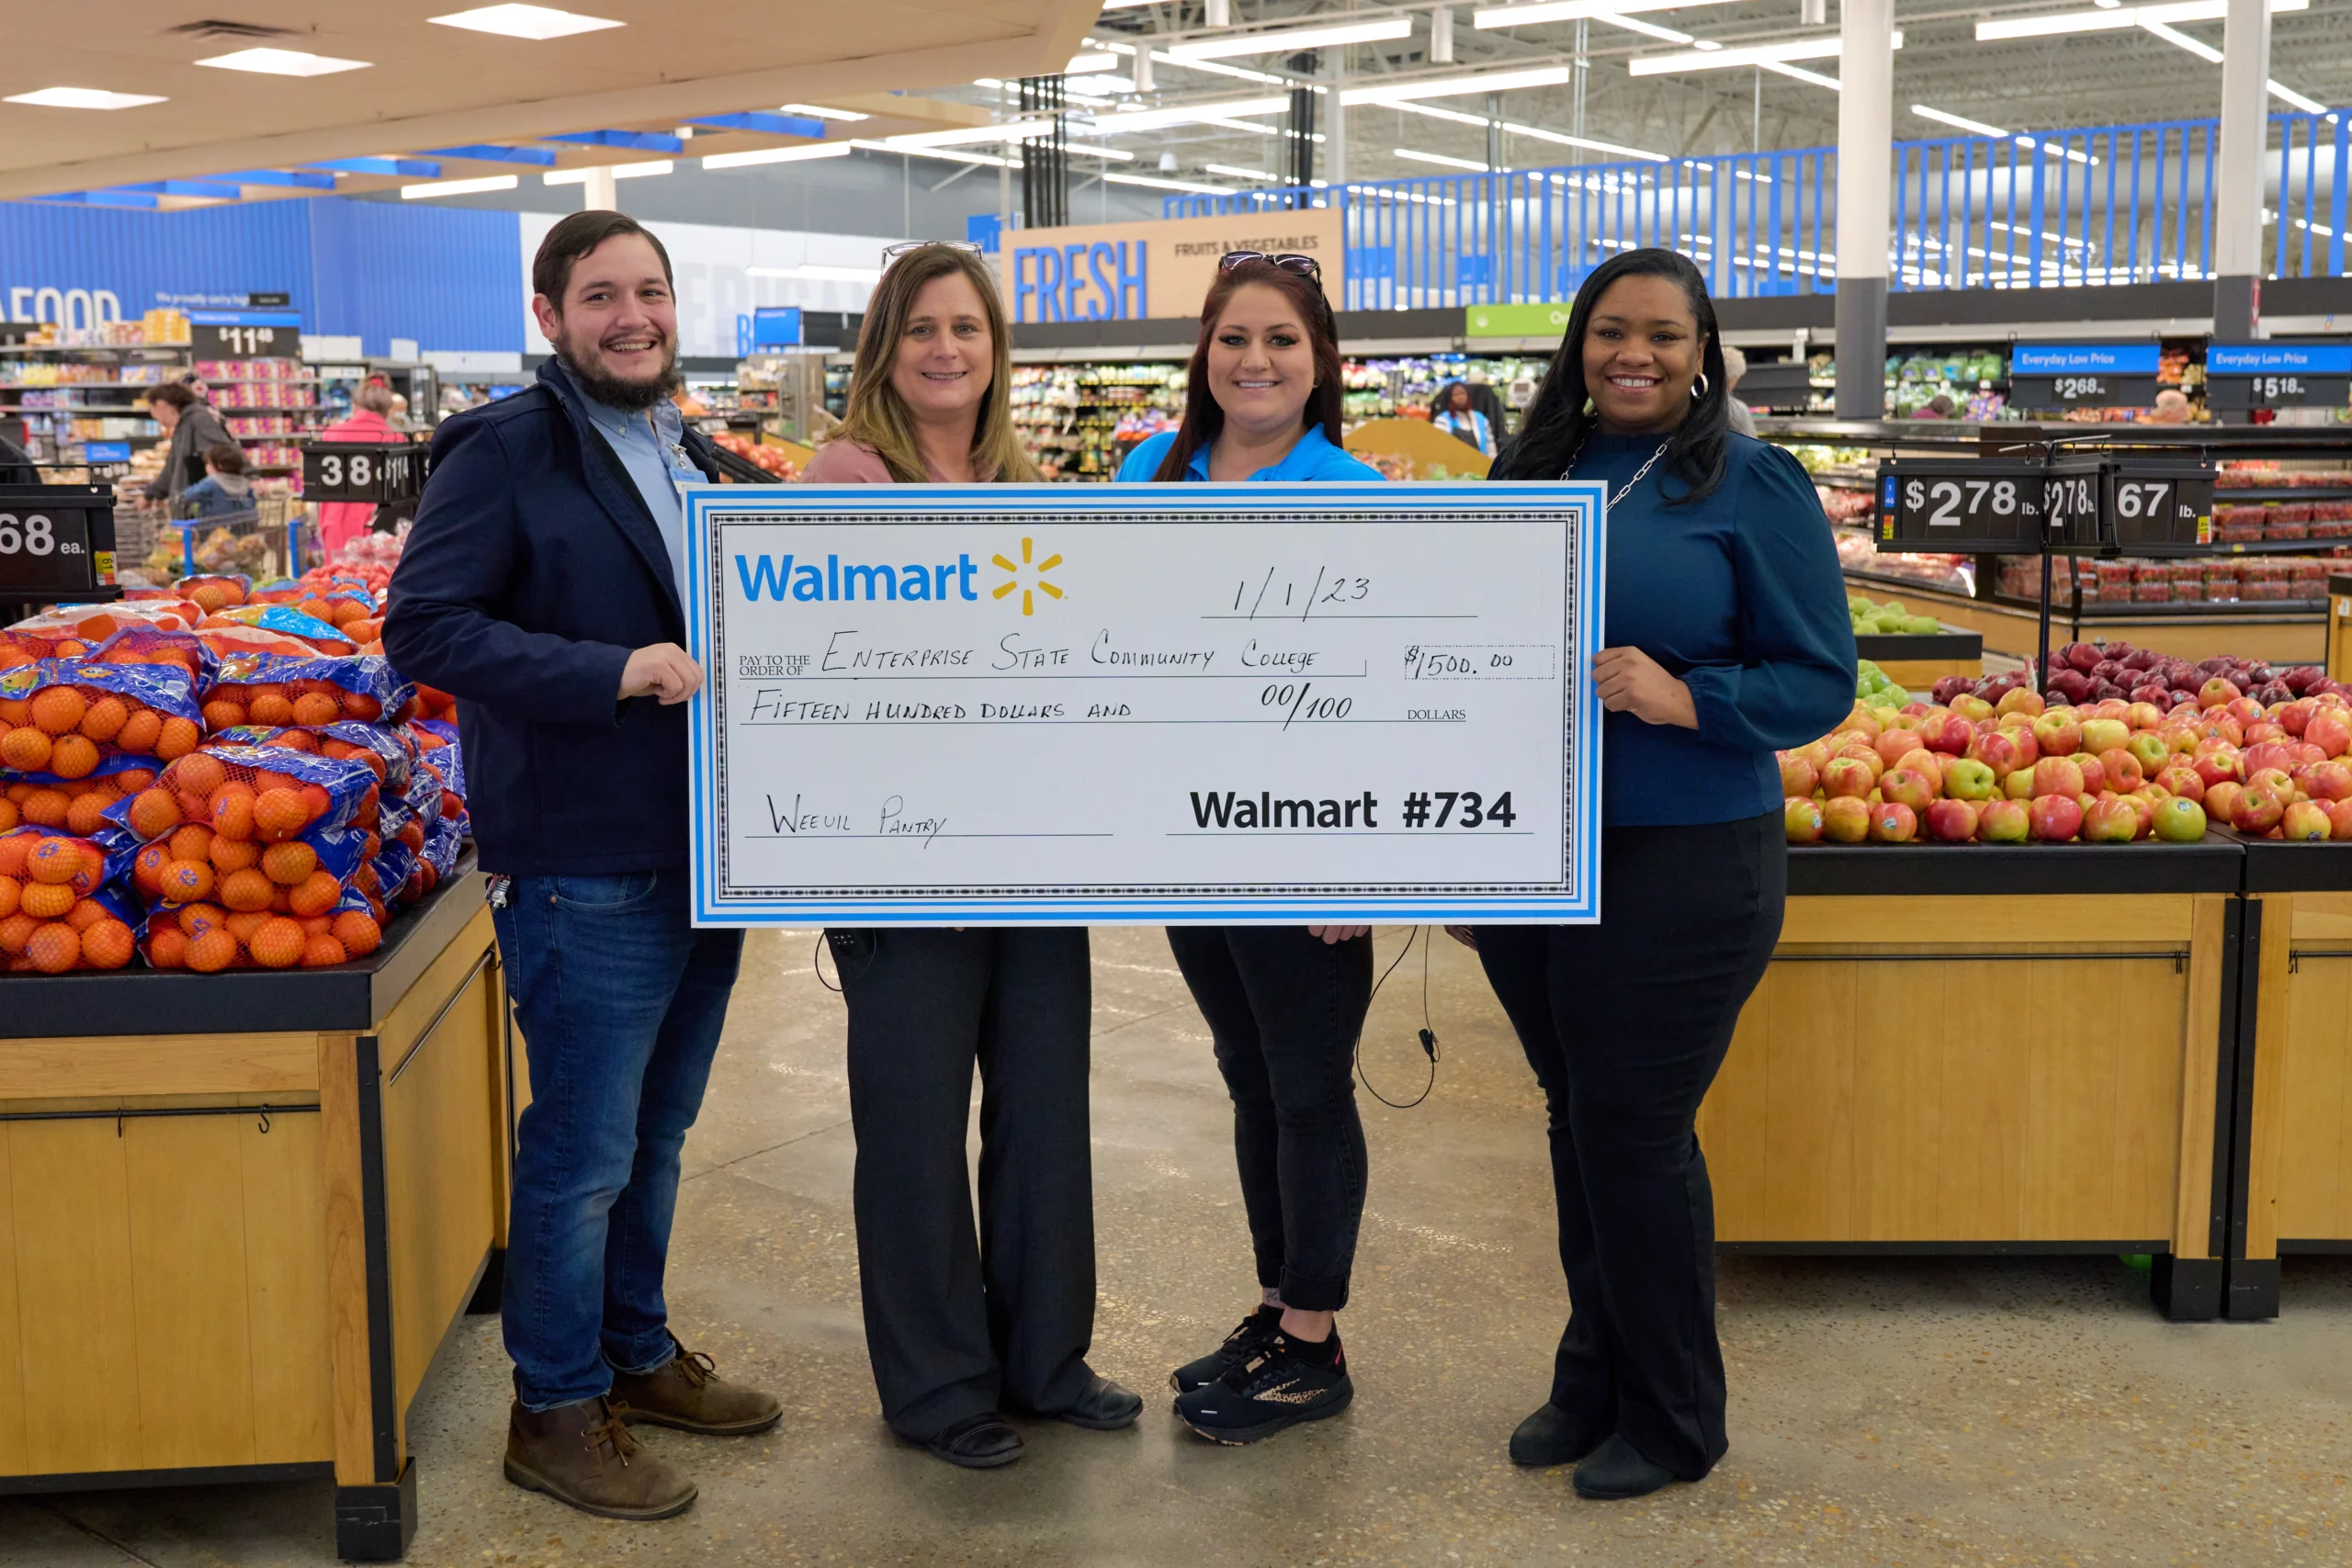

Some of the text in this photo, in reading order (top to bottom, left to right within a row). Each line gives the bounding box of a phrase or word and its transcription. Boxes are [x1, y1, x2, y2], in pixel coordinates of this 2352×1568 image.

[1175, 242, 1220, 257] FRUITS
[1235, 235, 1318, 253] VEGETABLES
[1013, 240, 1147, 324] FRESH
[0, 287, 121, 332] FOOD
[2022, 353, 2115, 367] Everyday Low Price
[2215, 353, 2308, 367] Everyday Low Price
[2054, 378, 2098, 399] $268
[1905, 479, 2040, 526] $278 lb.
[2117, 483, 2197, 518] 67 lb.
[60, 541, 85, 555] ea.
[735, 553, 978, 602] Walmart
[1234, 565, 1371, 623] 1/1/23
[740, 655, 810, 665] PAY TO THE
[822, 630, 975, 671] ENTERPRISE
[991, 633, 1070, 671] STATE
[1091, 628, 1216, 672] COMMUNITY
[740, 666, 804, 676] ORDER OF
[865, 701, 967, 721] HUNDRED
[980, 702, 1066, 719] DOLLARS
[1087, 703, 1132, 718] AND
[1261, 682, 1352, 732] 00/100
[1407, 709, 1466, 720] DOLLARS
[879, 795, 947, 850] PANTRY
[1190, 790, 1517, 829] Walmart #734
